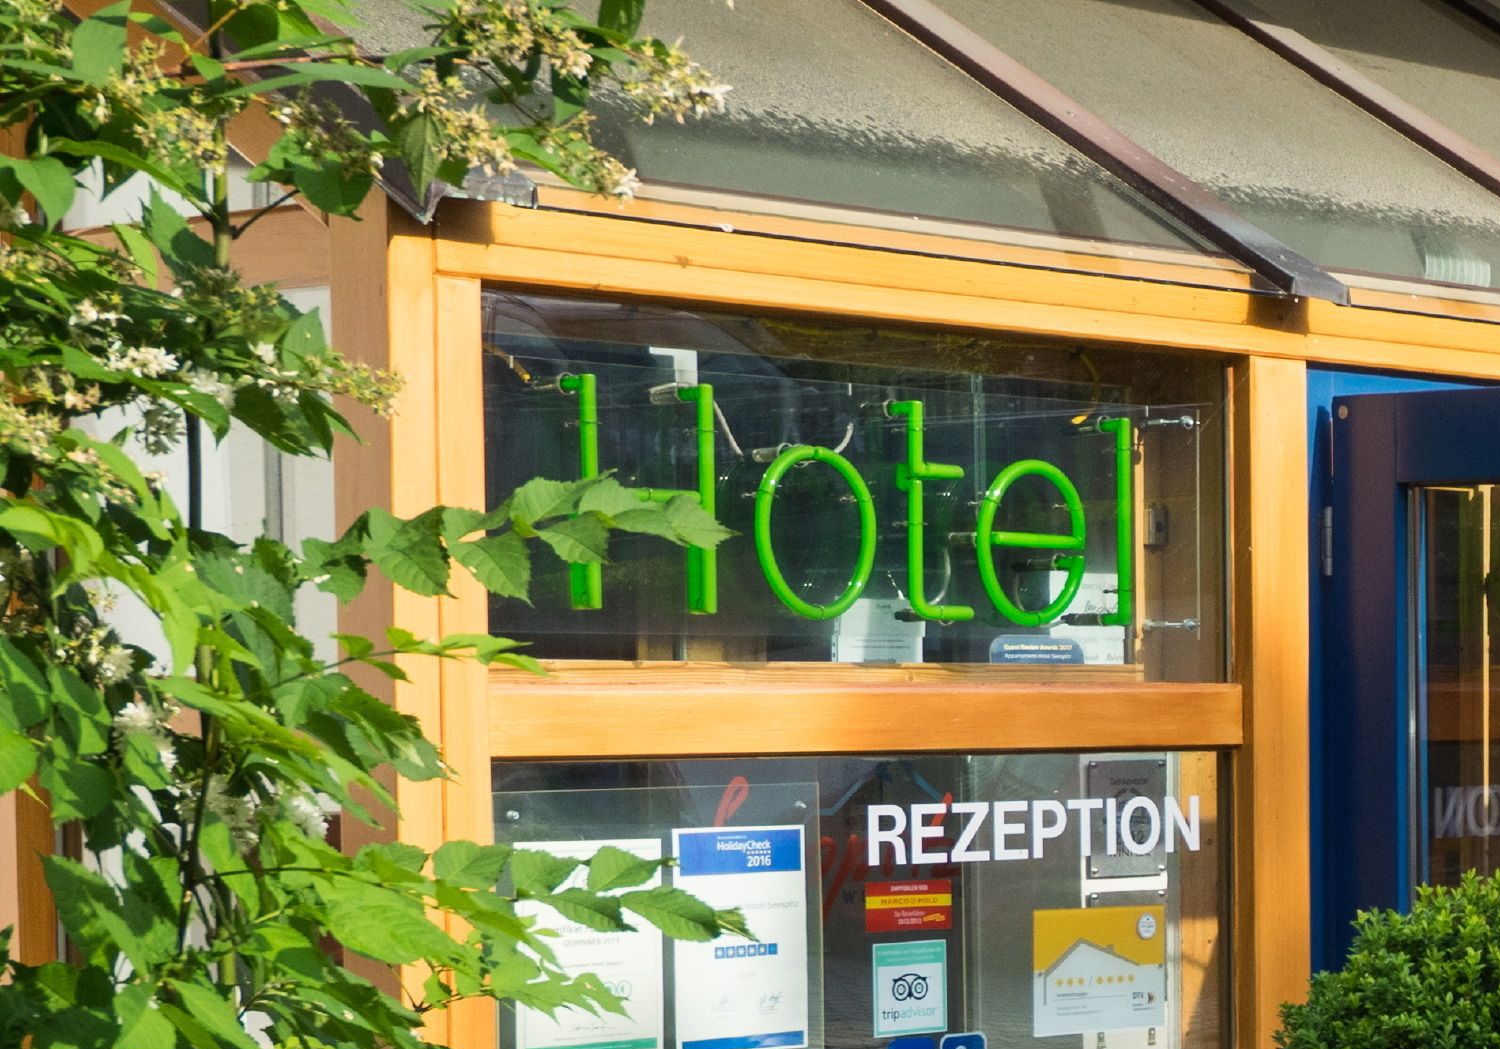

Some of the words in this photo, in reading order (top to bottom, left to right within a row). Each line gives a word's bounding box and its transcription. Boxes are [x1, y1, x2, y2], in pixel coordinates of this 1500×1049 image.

[560, 373, 1132, 627] Hotel
[866, 795, 1200, 867] REZEPTION
[717, 840, 771, 854] HolidayCheck
[746, 855, 772, 868] 2016
[882, 1006, 937, 1022] tripadvisor
